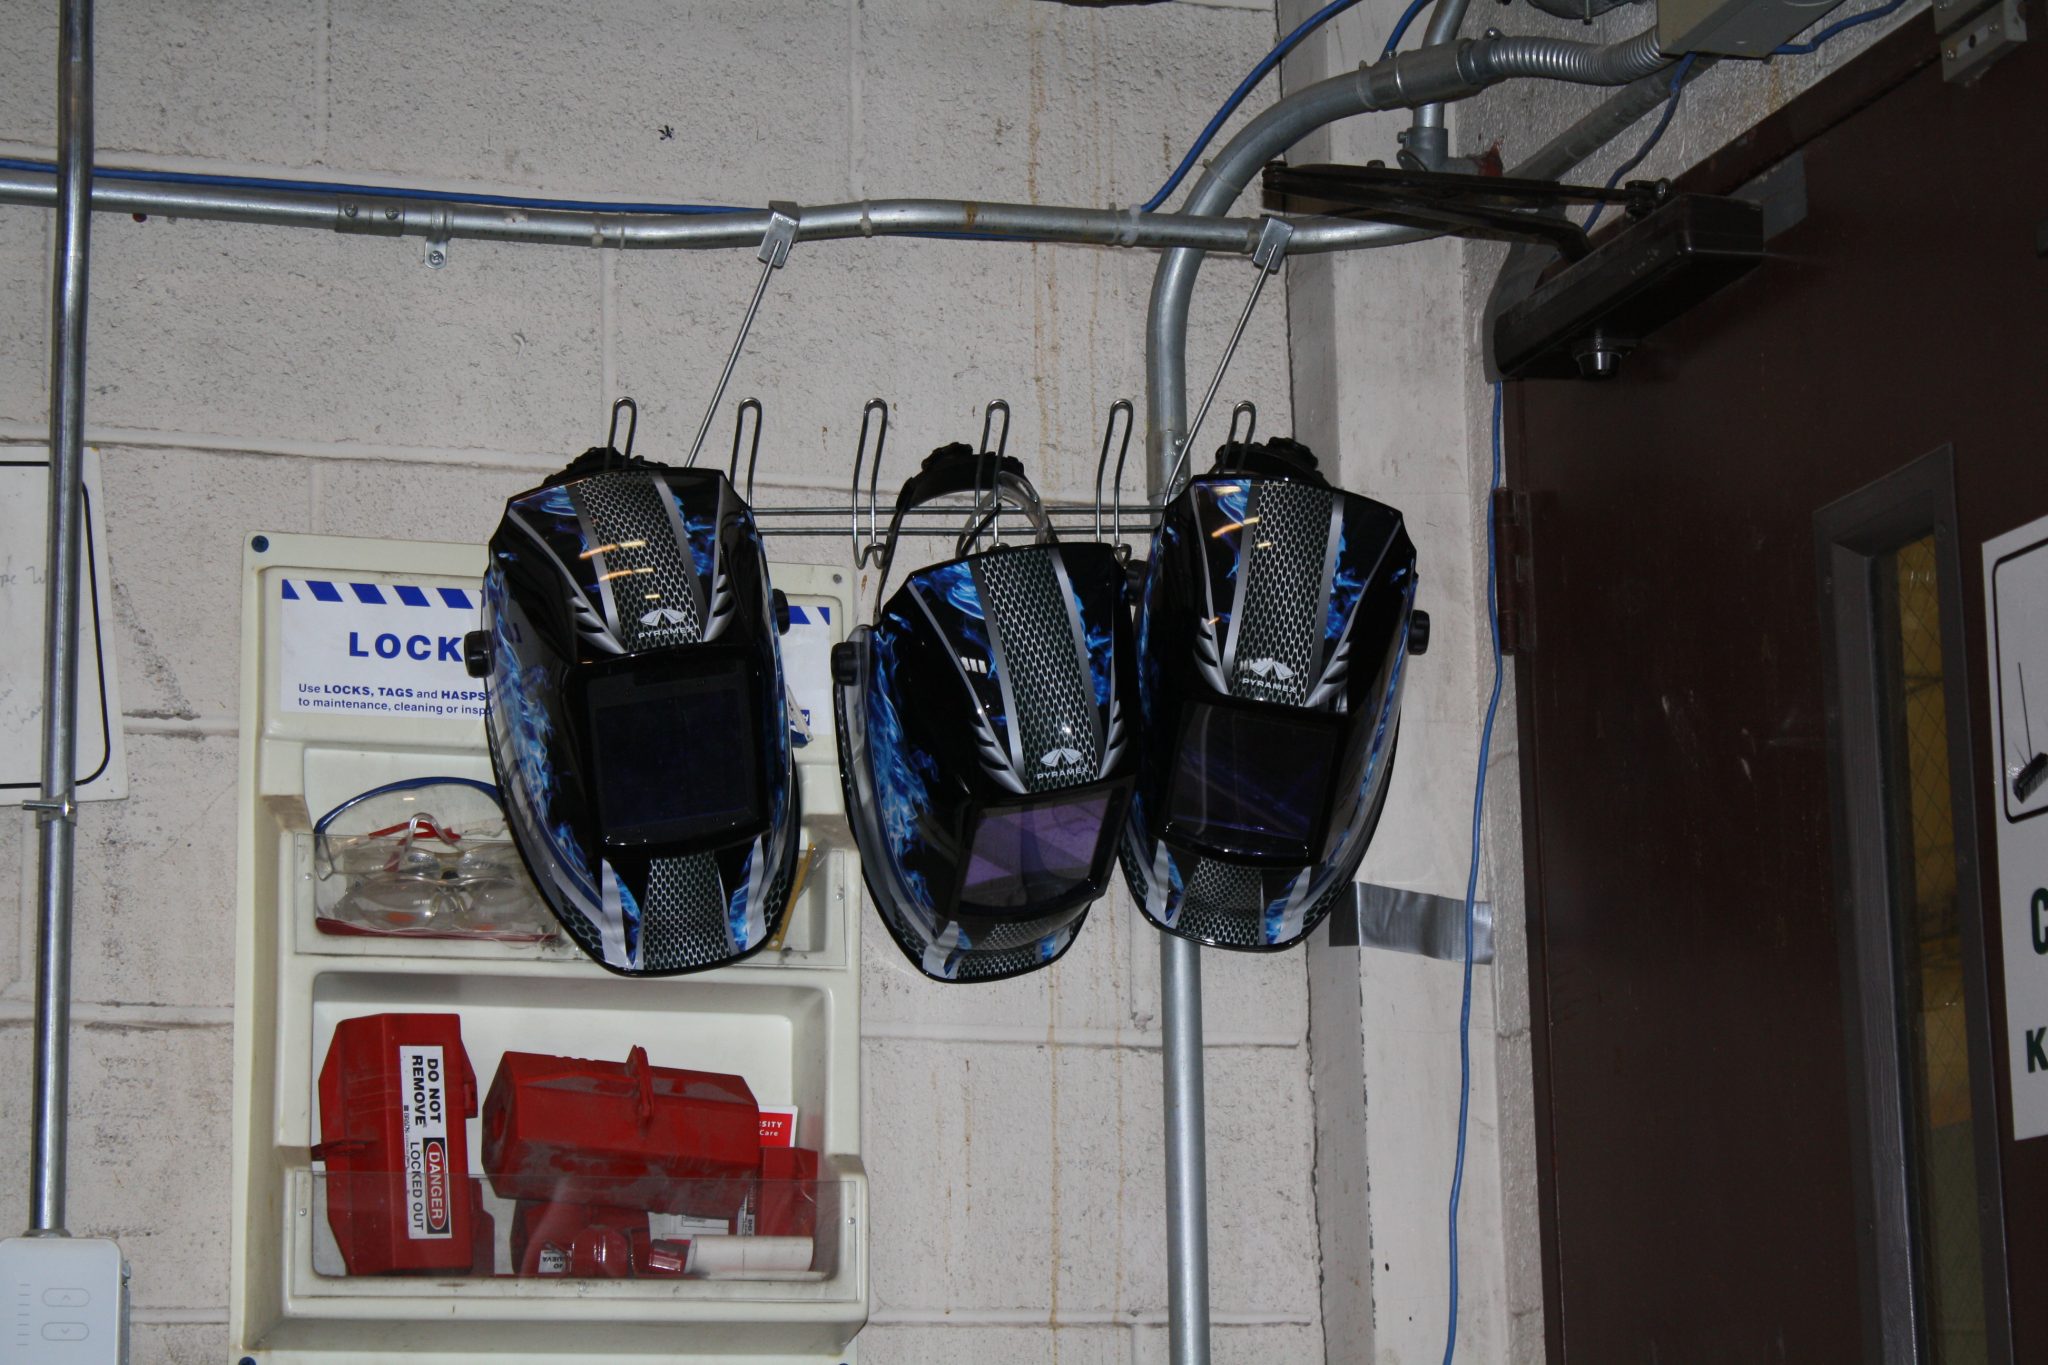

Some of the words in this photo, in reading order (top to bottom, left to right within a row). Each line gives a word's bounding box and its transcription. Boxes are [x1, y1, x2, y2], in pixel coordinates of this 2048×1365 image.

[638, 626, 694, 640] PYRAMEX
[349, 632, 464, 662] LOCK
[298, 683, 321, 694] Use
[324, 685, 374, 697] LOCKS,
[378, 687, 413, 698] TAGS
[416, 690, 437, 699] and
[441, 690, 486, 701] HASPS
[1242, 677, 1297, 693] PYRAMEX
[298, 697, 310, 706] to
[313, 698, 391, 711] maintenance,
[394, 702, 442, 715] cleaning
[446, 705, 458, 714] or
[1036, 766, 1089, 780] PYRAMEX
[427, 1058, 440, 1082] DO
[412, 1055, 426, 1126] REMOVE
[429, 1088, 442, 1123] NOT
[759, 1120, 783, 1128] SITY
[759, 1129, 779, 1137] Care
[410, 1142, 423, 1198] LOCKED
[428, 1151, 443, 1219] DANGER
[412, 1202, 424, 1230] OUT
